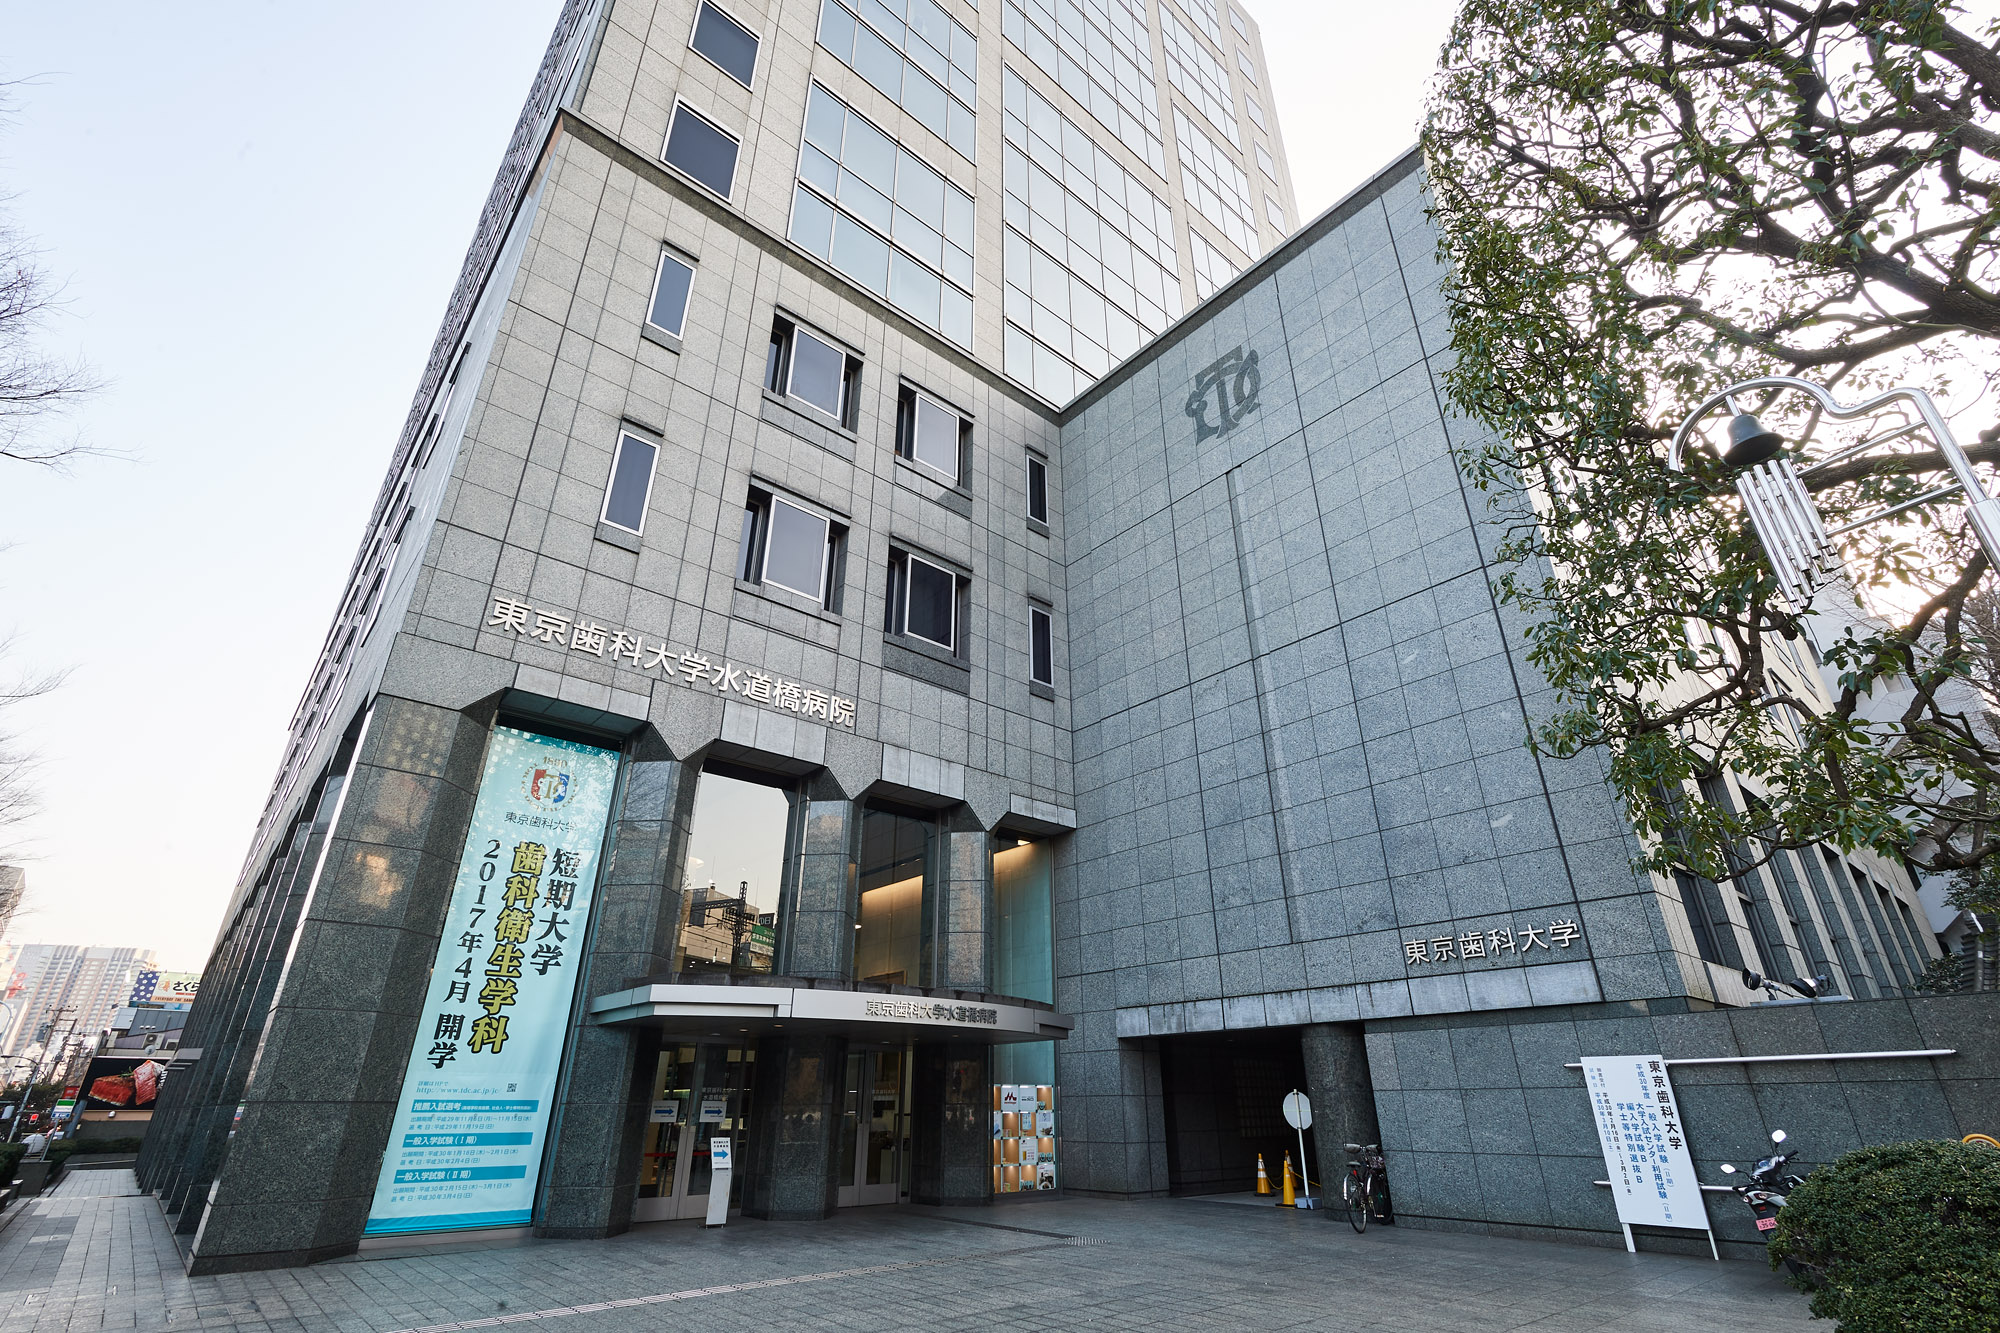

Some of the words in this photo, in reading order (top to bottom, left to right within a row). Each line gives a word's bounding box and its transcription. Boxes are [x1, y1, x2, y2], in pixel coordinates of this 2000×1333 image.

[487, 596, 856, 727] 東京歯科大学水道橋病院
[504, 811, 577, 833] 東京歯科大学
[443, 839, 501, 1004] 2017年4月
[467, 841, 547, 1054] 歯科衛生学科
[530, 848, 580, 976] 短期大学
[1403, 919, 1580, 965] 東京歯科大学
[427, 1013, 466, 1069] 開学
[865, 999, 998, 1025] 東京歯科大学水道橋病院
[1635, 1064, 1651, 1100] 平成30年度
[1648, 1060, 1682, 1150] 東京歯科大学
[1617, 1102, 1643, 1184] 学士等特別選抜B
[1626, 1102, 1647, 1163] 編入学試験B
